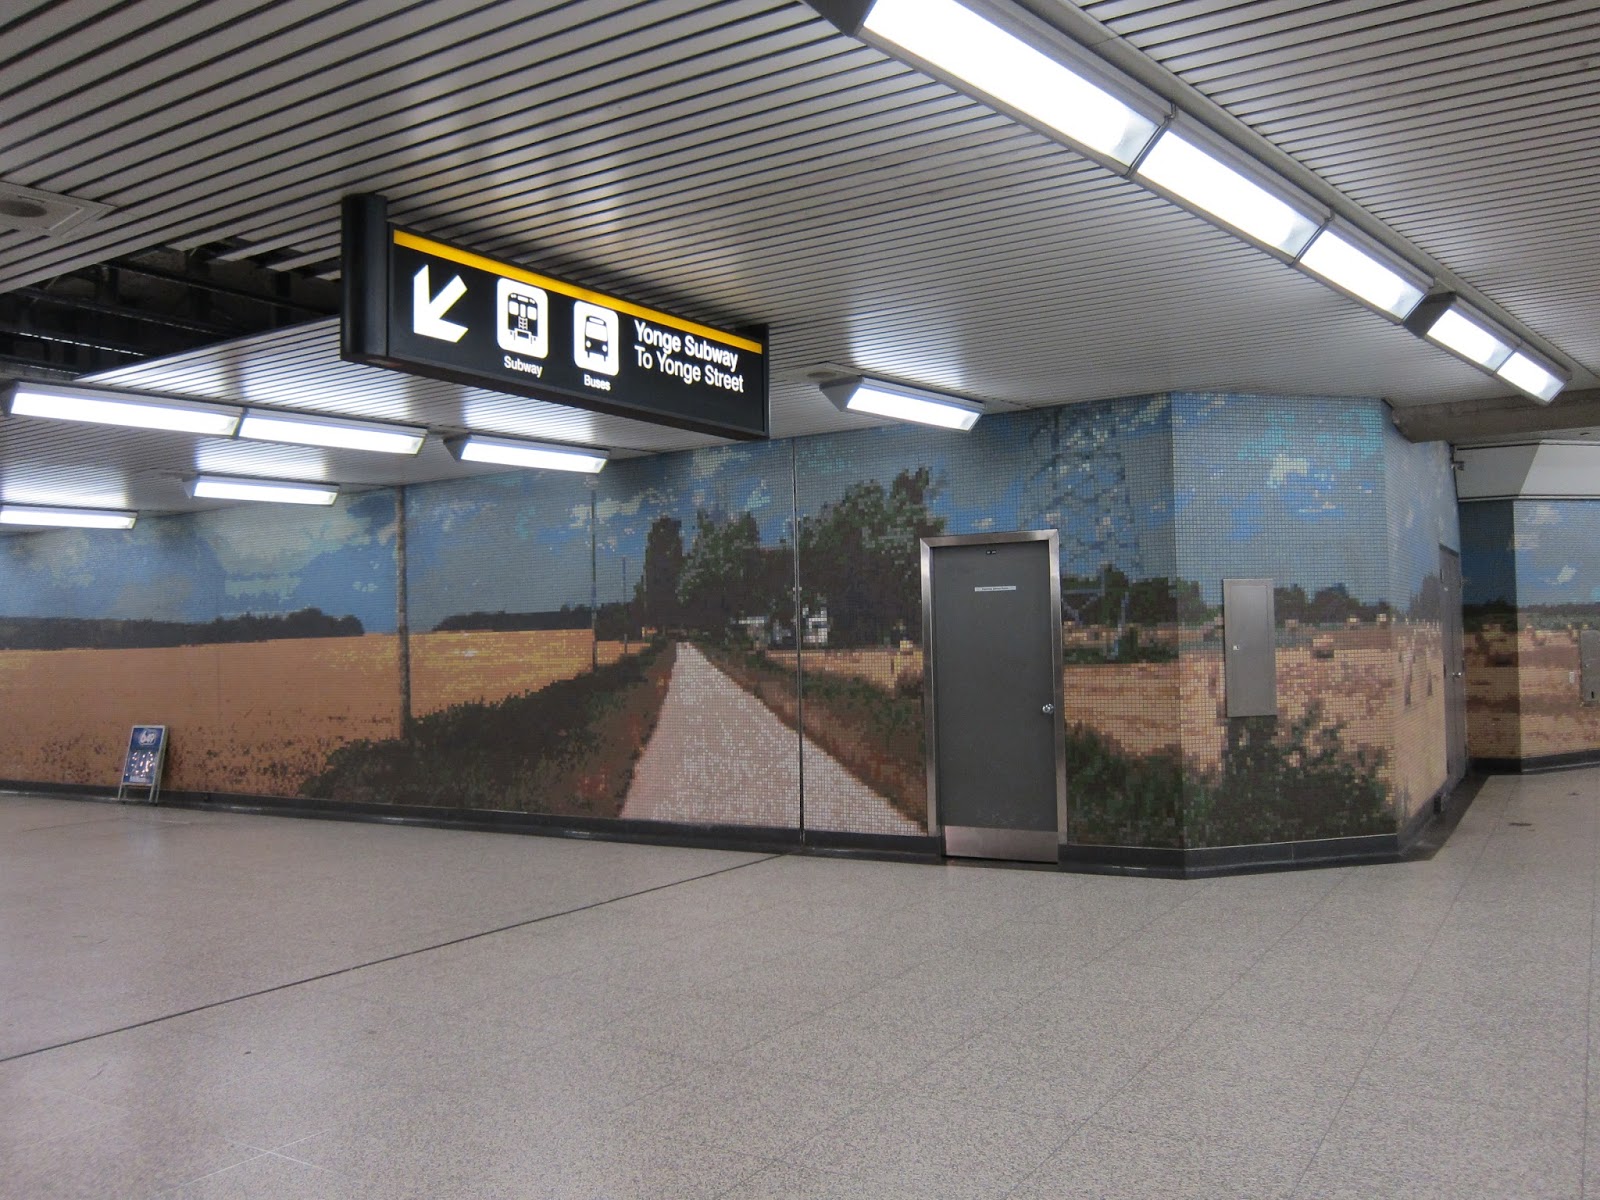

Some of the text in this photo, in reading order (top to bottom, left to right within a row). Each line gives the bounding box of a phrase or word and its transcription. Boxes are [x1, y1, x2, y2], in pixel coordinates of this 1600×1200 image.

[634, 319, 738, 372] Yonge Subway
[503, 355, 543, 378] Subway
[583, 374, 611, 391] Buses
[634, 345, 744, 393] To Yonge Street
